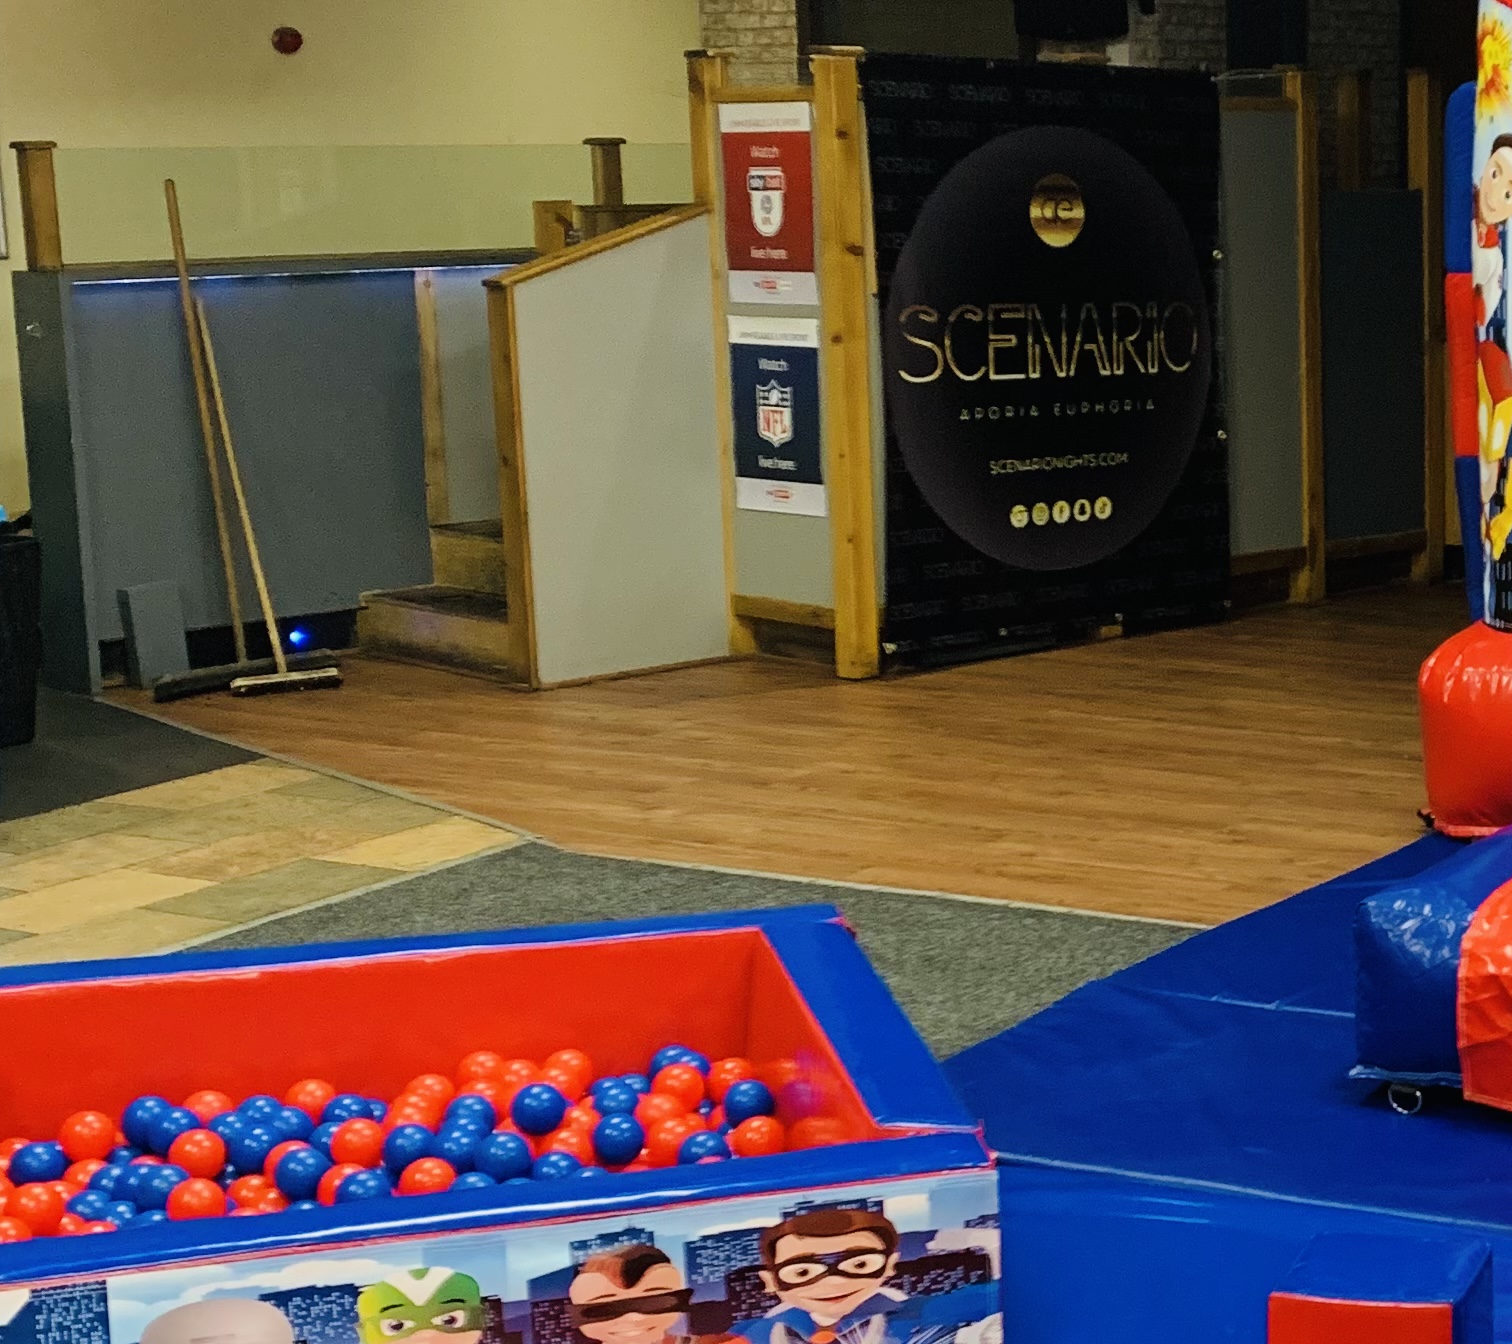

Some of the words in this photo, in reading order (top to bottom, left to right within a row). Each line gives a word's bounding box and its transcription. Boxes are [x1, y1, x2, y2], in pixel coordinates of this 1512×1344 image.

[898, 302, 1199, 384] SCENARIO
[1053, 399, 1155, 416] EUPHORIA
[761, 408, 787, 437] NFL
